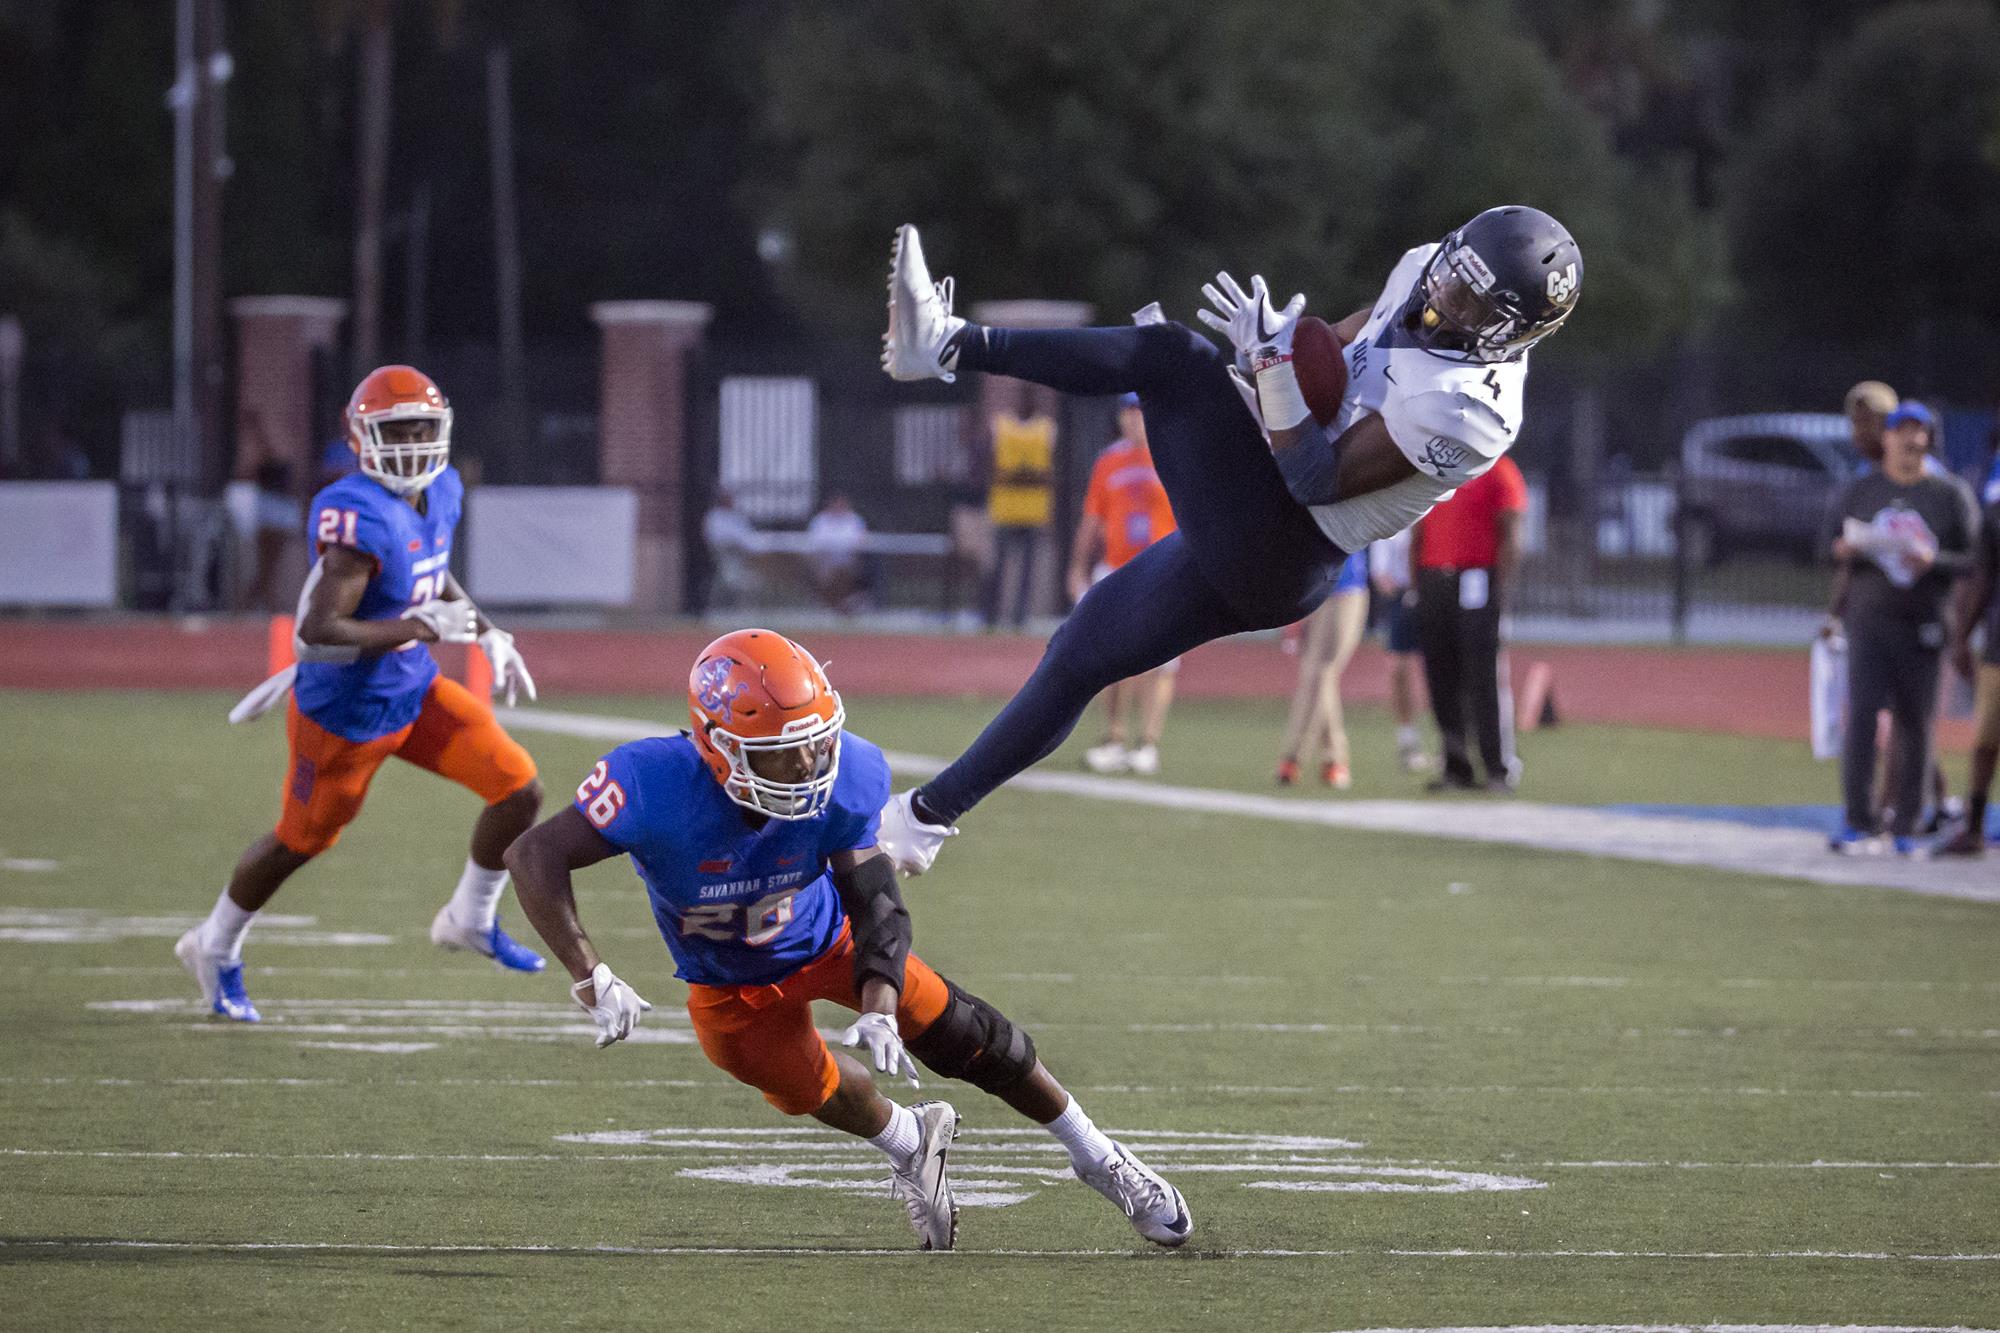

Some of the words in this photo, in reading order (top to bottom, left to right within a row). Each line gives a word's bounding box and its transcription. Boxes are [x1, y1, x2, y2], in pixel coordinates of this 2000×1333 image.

[1546, 262, 1577, 303] CSU
[1482, 368, 1502, 401] 4
[1428, 435, 1471, 466] CSU
[317, 507, 358, 545] 21
[788, 716, 819, 733] Riddell
[576, 760, 626, 829] 26
[698, 878, 761, 899] SAVANNAH
[767, 871, 803, 889] STATE
